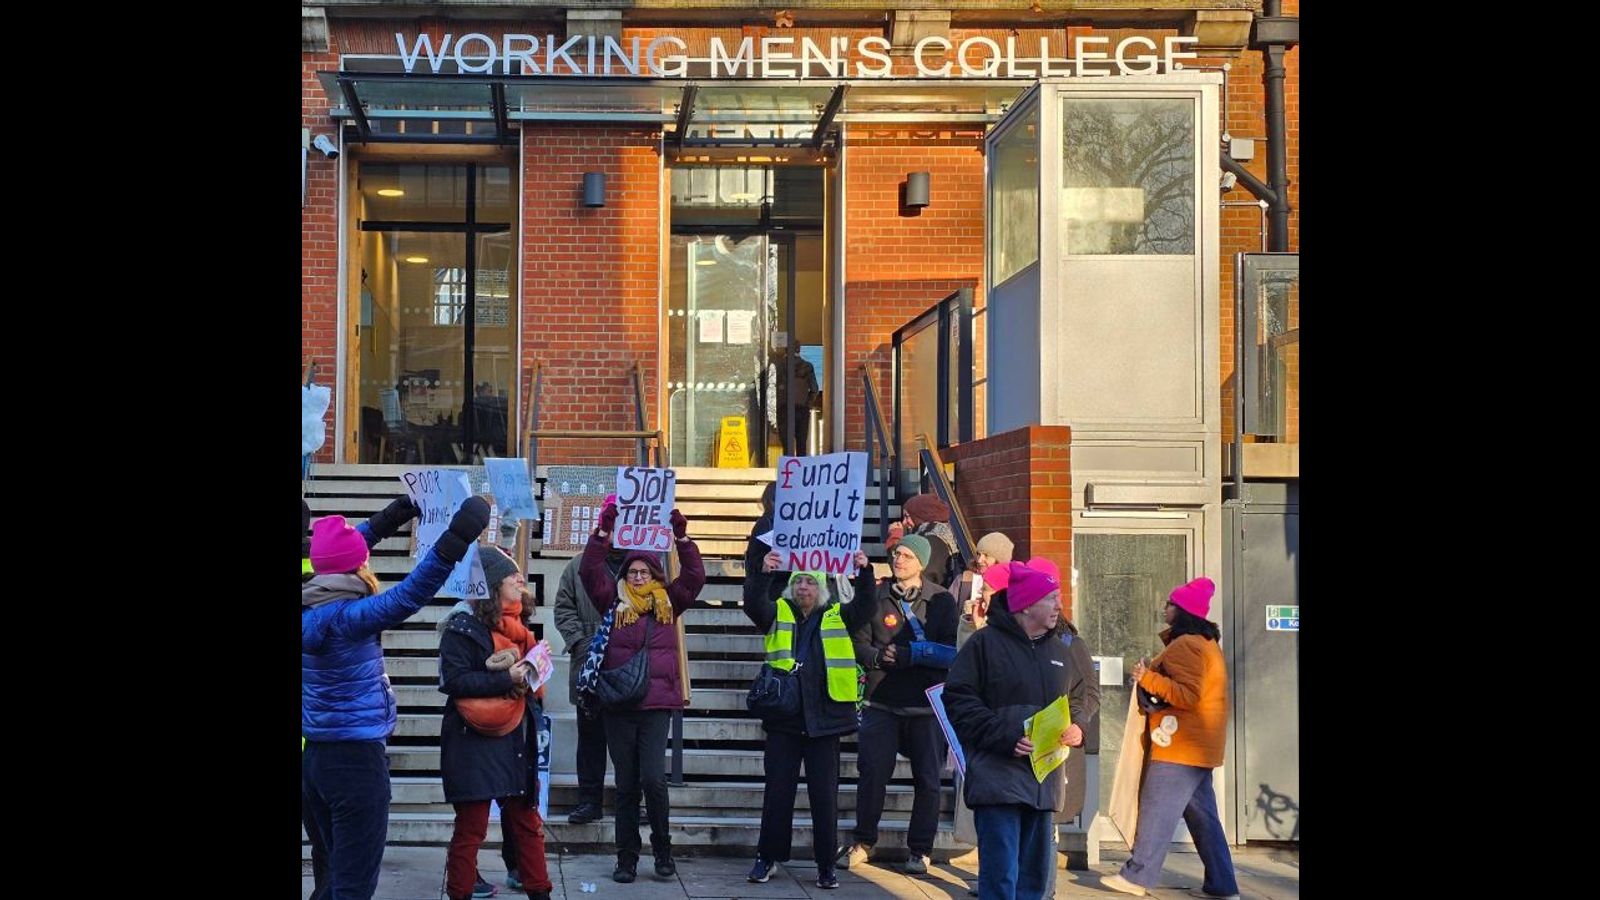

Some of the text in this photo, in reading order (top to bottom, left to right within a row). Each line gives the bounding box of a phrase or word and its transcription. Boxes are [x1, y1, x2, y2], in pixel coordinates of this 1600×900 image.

[395, 33, 1199, 78] WORKING MEN'S COLLEGE
[619, 468, 675, 504] STOP
[620, 505, 661, 524] THE
[780, 489, 860, 521] adult
[618, 525, 672, 549] CUTS
[776, 524, 858, 550] education
